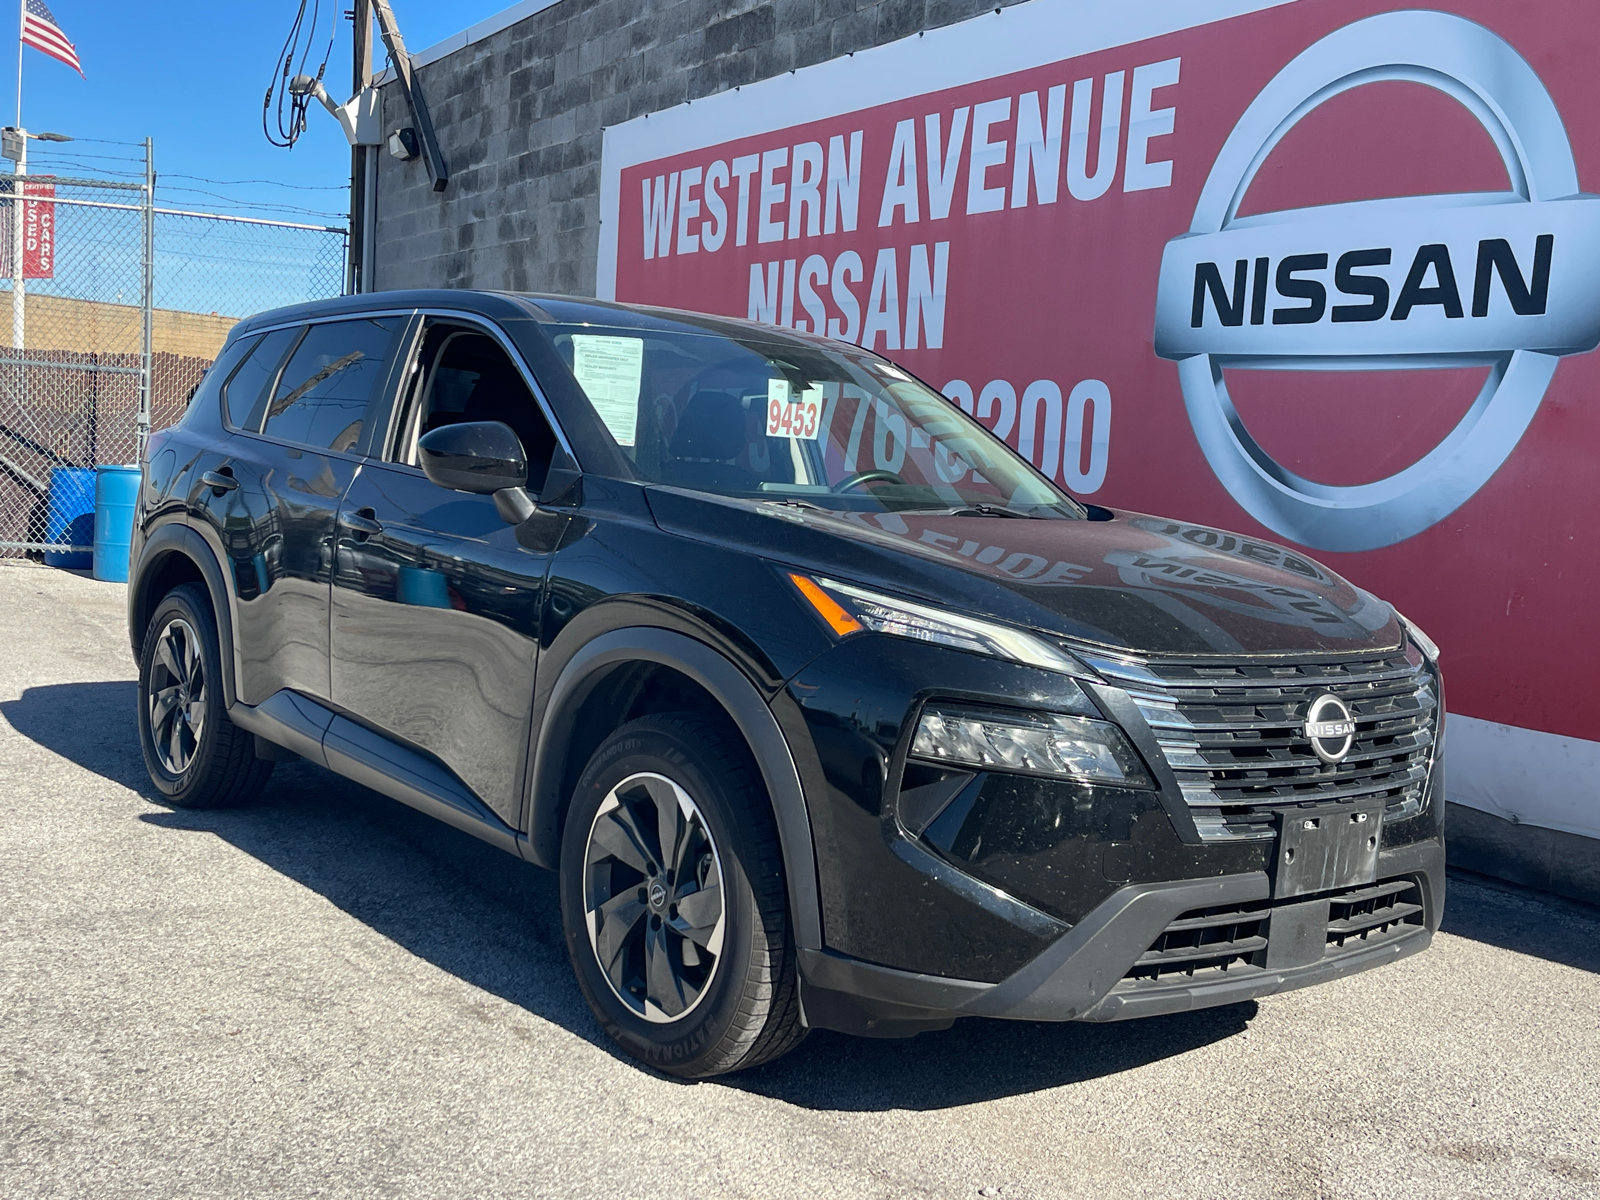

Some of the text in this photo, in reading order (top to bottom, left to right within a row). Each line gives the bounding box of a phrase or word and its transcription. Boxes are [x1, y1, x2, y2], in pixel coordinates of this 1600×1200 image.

[642, 57, 1181, 260] WESTERN AVENUE
[26, 194, 38, 251] USED
[40, 213, 51, 271] CARS
[748, 241, 950, 350] NISSAN
[1191, 234, 1554, 328] NISSAN
[769, 399, 817, 437] 9453
[1308, 722, 1355, 735] NISSAN
[582, 742, 624, 787] COMMANDO
